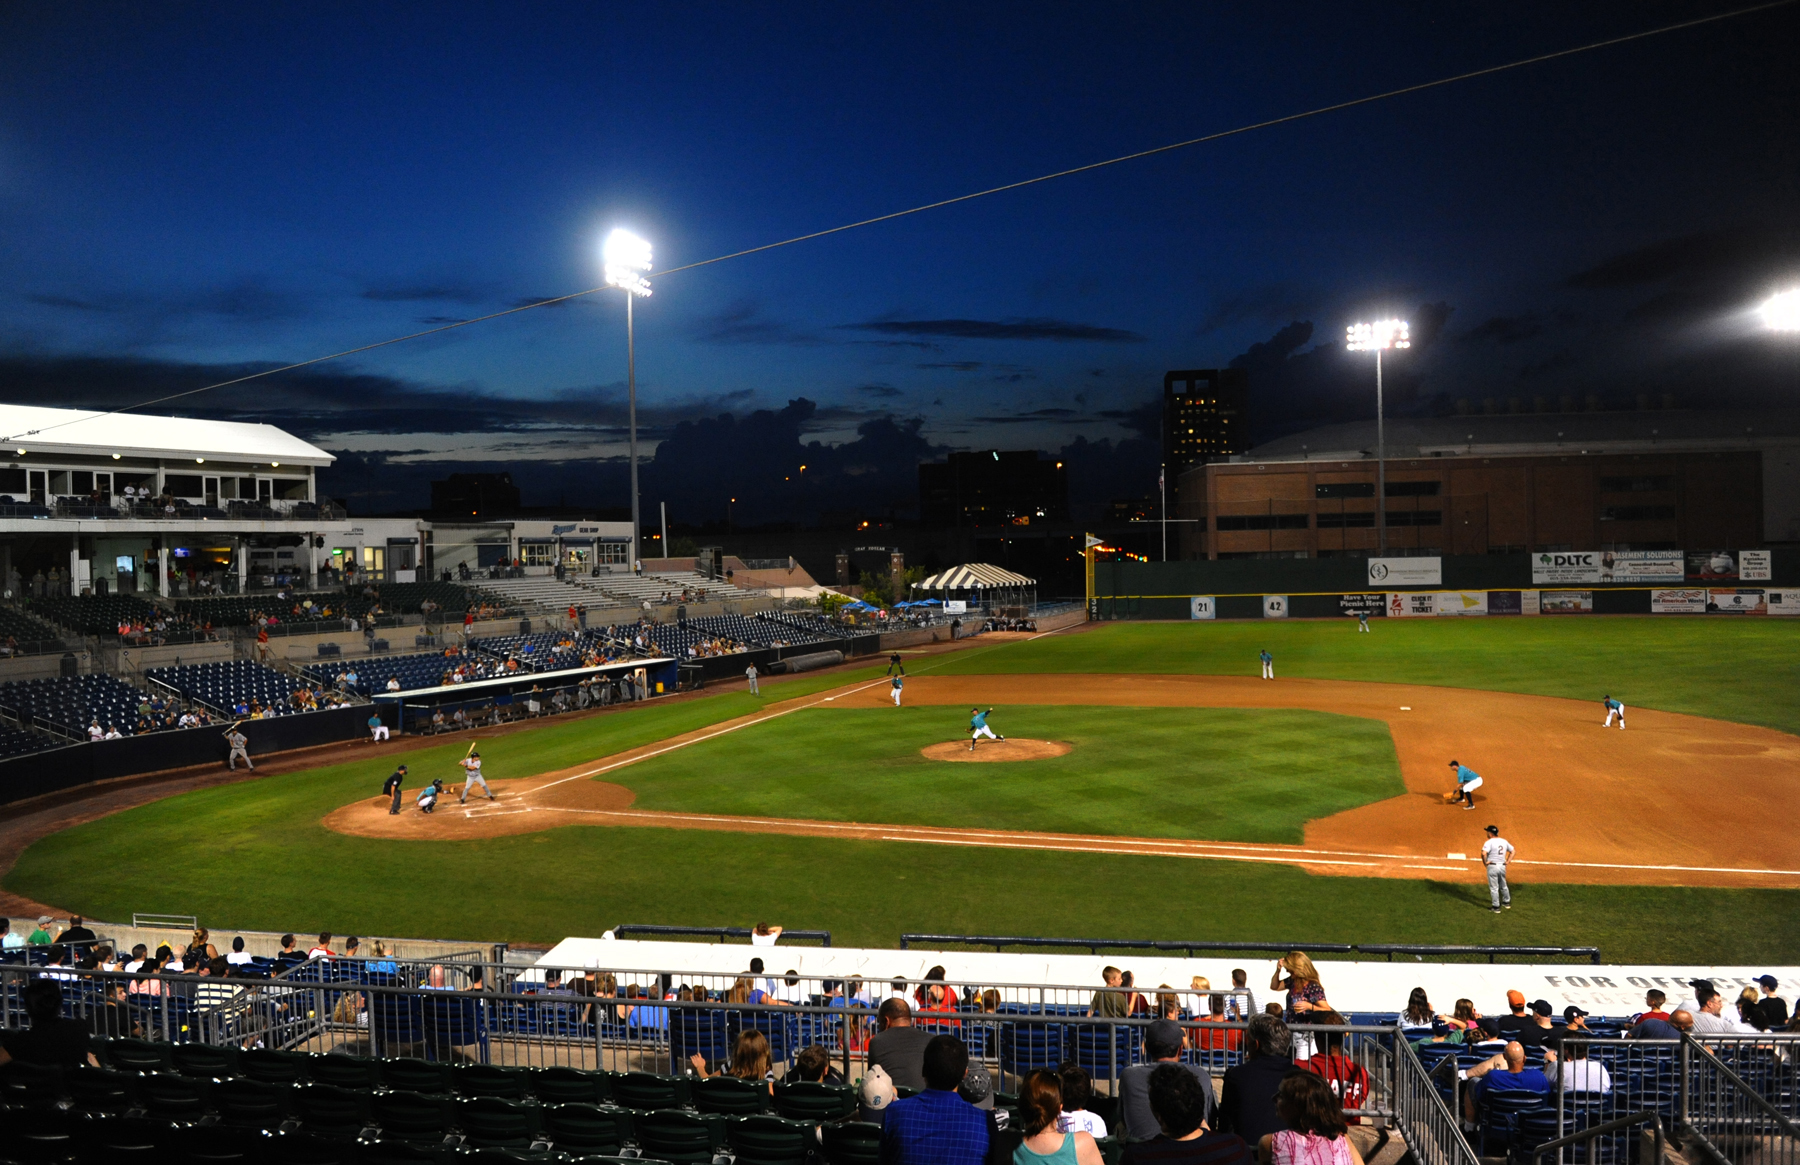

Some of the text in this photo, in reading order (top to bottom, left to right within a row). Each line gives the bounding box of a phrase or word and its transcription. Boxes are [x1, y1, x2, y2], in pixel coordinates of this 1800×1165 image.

[1616, 551, 1683, 559] ASEMENT SOLUTIONS!
[1554, 554, 1592, 566] DLTC
[1198, 603, 1208, 612] 21
[1269, 602, 1281, 611] 42
[1411, 606, 1433, 614] TICKET
[1498, 845, 1504, 855] 2
[1544, 975, 1754, 989] FOR OFFCE
